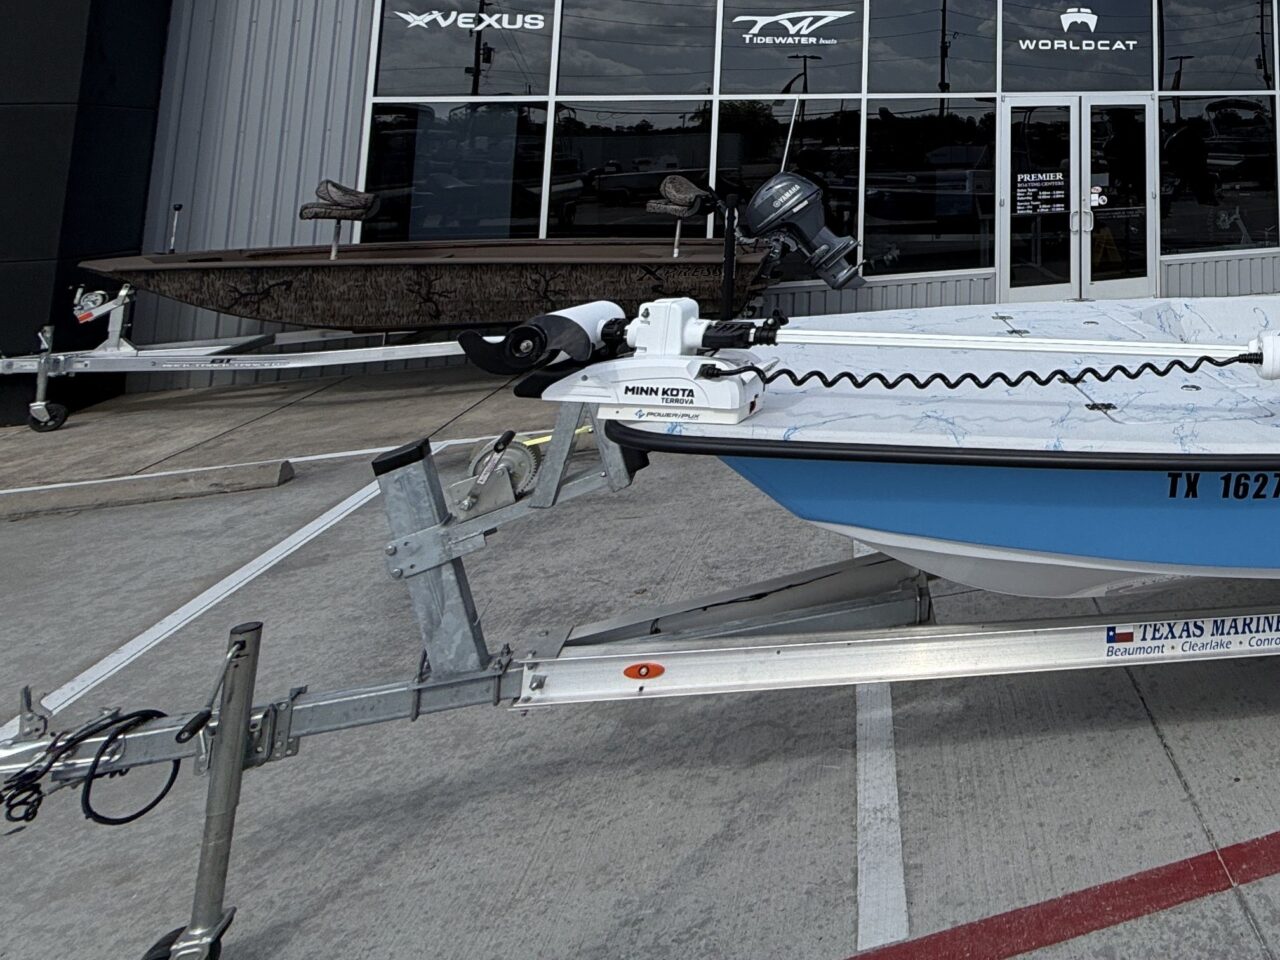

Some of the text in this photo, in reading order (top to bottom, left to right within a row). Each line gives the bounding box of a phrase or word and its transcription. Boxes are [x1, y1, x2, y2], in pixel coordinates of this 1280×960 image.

[431, 10, 545, 31] VEXUS
[1019, 39, 1138, 51] WORLDCAT
[1017, 172, 1064, 182] PREMIER
[778, 184, 801, 203] YAMAHA
[624, 385, 695, 398] MINN KOTA
[661, 397, 695, 405] TERROVA
[1167, 472, 1201, 499] TX
[1138, 620, 1205, 642] TEXAS
[1106, 644, 1165, 657] Beaumont
[1181, 639, 1232, 653] Clearlake
